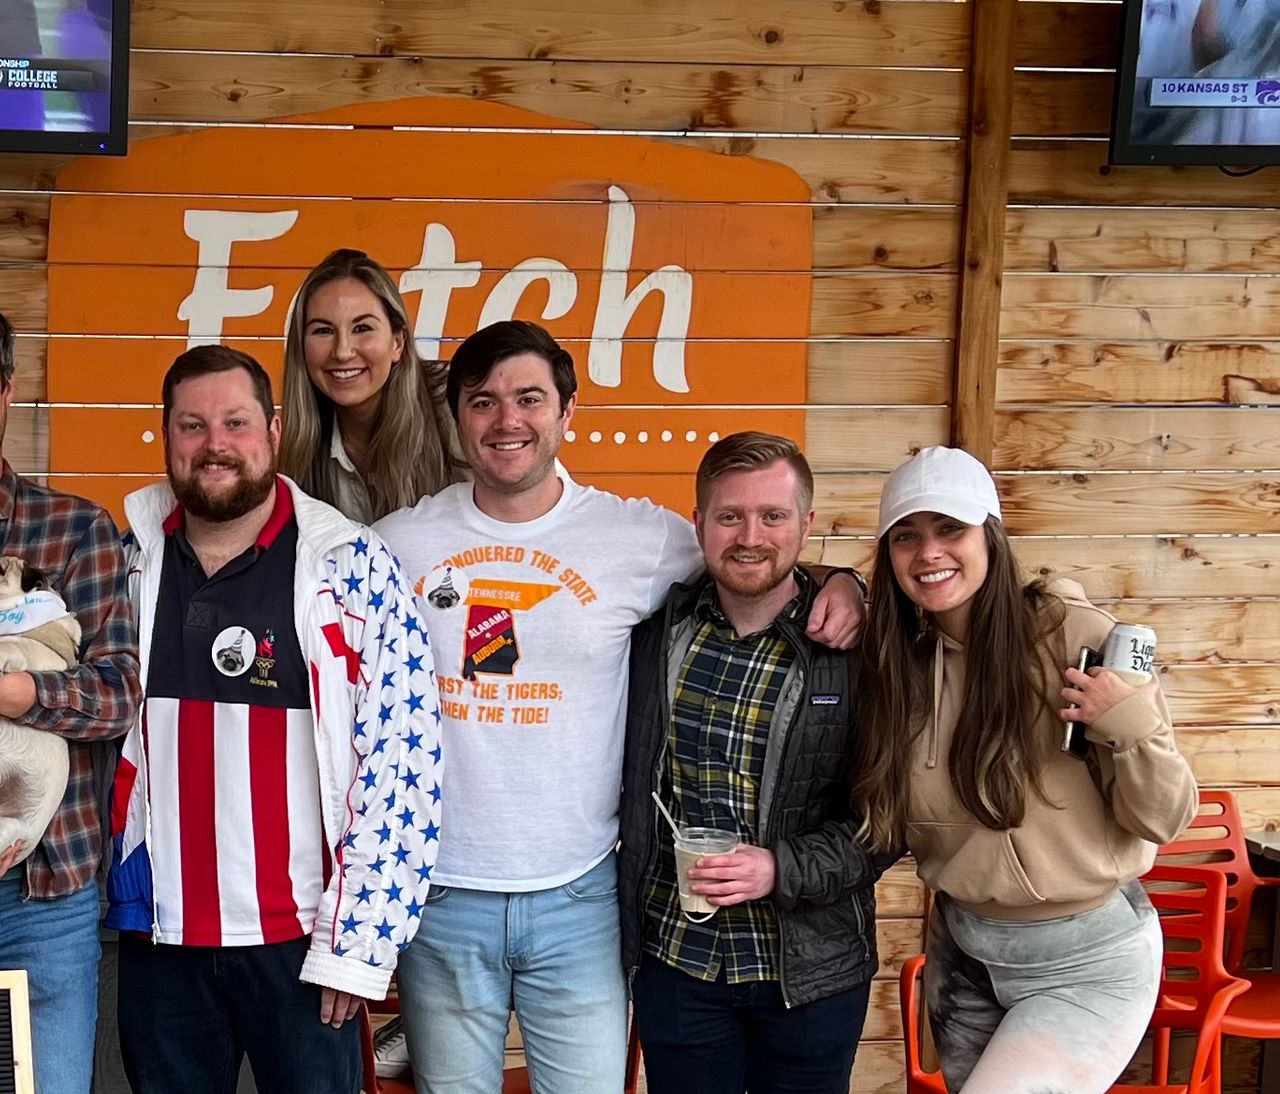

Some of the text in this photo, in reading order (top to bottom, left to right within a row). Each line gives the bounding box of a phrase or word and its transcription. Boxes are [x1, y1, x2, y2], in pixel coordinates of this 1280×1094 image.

[8, 69, 58, 83] COLLEGE
[8, 81, 58, 89] FOOTBALL
[1161, 82, 1249, 93] 10 KANSAS ST
[177, 185, 694, 394] Ftch
[431, 546, 598, 607] NQUERED THE STATE
[469, 587, 521, 600] TENNESSEE
[466, 609, 511, 640] ALABAMA
[472, 634, 507, 665] AUBURN
[436, 675, 464, 696] RST
[472, 680, 499, 700] THE
[440, 700, 550, 724] HEN THE TIDE!
